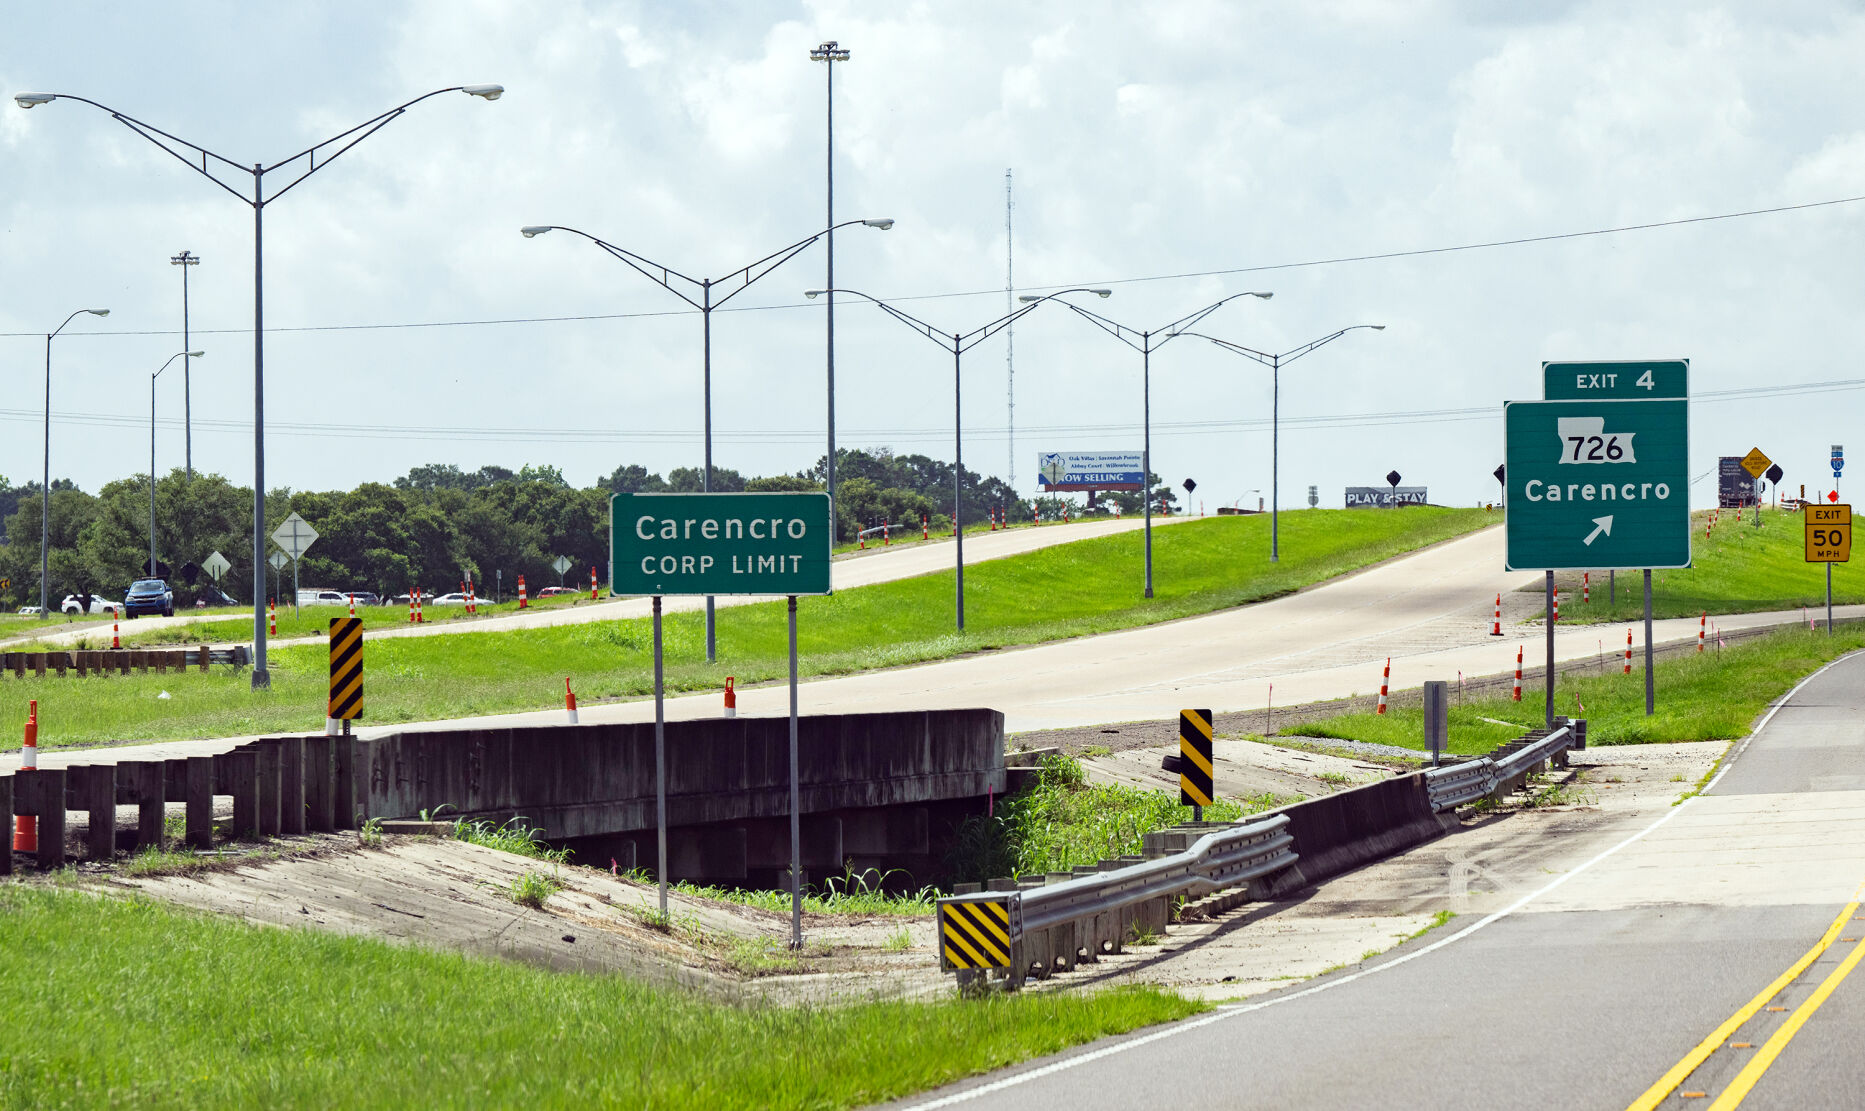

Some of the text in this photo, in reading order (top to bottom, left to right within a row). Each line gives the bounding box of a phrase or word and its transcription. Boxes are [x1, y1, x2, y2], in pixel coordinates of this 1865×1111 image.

[1576, 370, 1655, 391] EXIT 4
[1568, 436, 1624, 461] 726
[1061, 473, 1124, 482] OW SELLING
[1347, 493, 1378, 504] PLAY
[1395, 493, 1426, 503] STAY
[1525, 479, 1670, 502] Carencro
[1815, 510, 1841, 520] EXIT
[635, 515, 807, 540] Carencro
[1813, 530, 1843, 547] 50
[641, 555, 802, 575] CORP LIMIT
